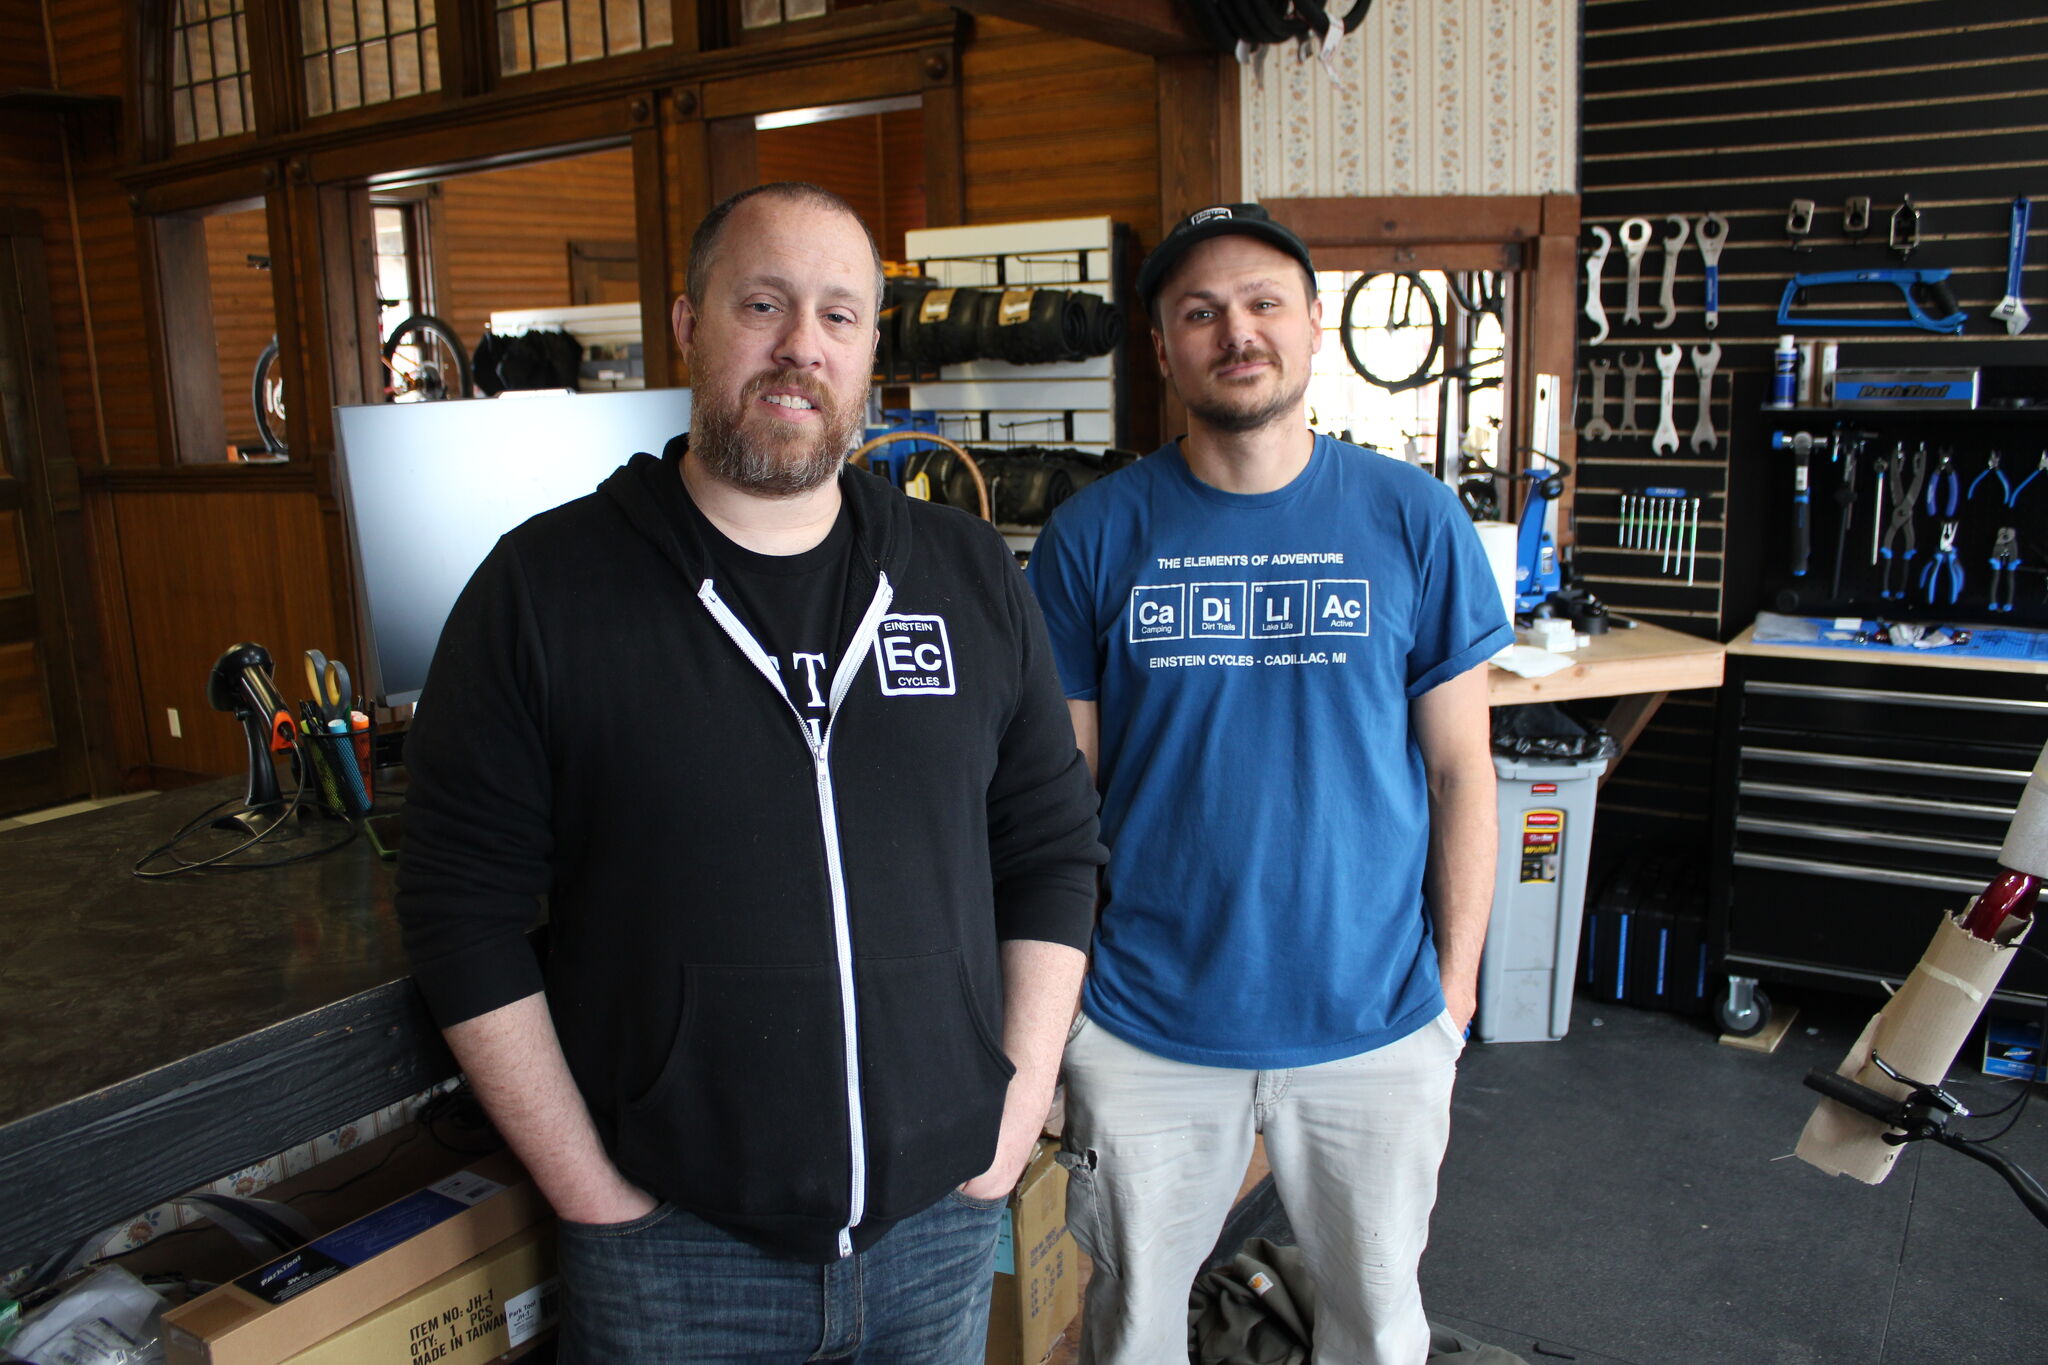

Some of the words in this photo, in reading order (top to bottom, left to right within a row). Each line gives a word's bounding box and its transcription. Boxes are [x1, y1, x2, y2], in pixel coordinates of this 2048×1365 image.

[1157, 557, 1181, 570] THE
[1184, 555, 1249, 568] ELEMENTS
[1251, 554, 1269, 566] OF
[1271, 553, 1344, 565] ADVENTURE
[1138, 601, 1175, 626] Ca
[1202, 597, 1231, 622] Di
[1321, 594, 1361, 619] Ac
[884, 622, 933, 632] EINSTEIN
[1141, 625, 1172, 634] Camping
[1202, 622, 1216, 631] Dirt
[1216, 623, 1236, 631] Trails
[1262, 623, 1279, 632] Lake
[1280, 621, 1294, 630] Life
[1330, 619, 1354, 628] Active
[883, 636, 942, 672] Ec
[1149, 655, 1206, 669] EINSTEIN
[1208, 654, 1254, 666] CYCLES
[1264, 653, 1329, 666] CADILLAC,
[1332, 652, 1347, 664] MI
[897, 676, 940, 687] CYCLES
[409, 1316, 439, 1342] ITEM
[443, 1306, 464, 1326] NO:
[466, 1288, 494, 1314] JH-1
[450, 1325, 456, 1338] 1
[470, 1305, 493, 1326] PCS
[508, 1308, 523, 1318] Park
[412, 1343, 447, 1365] MADE
[450, 1334, 463, 1352] IN
[466, 1311, 507, 1343] TAIWAN
